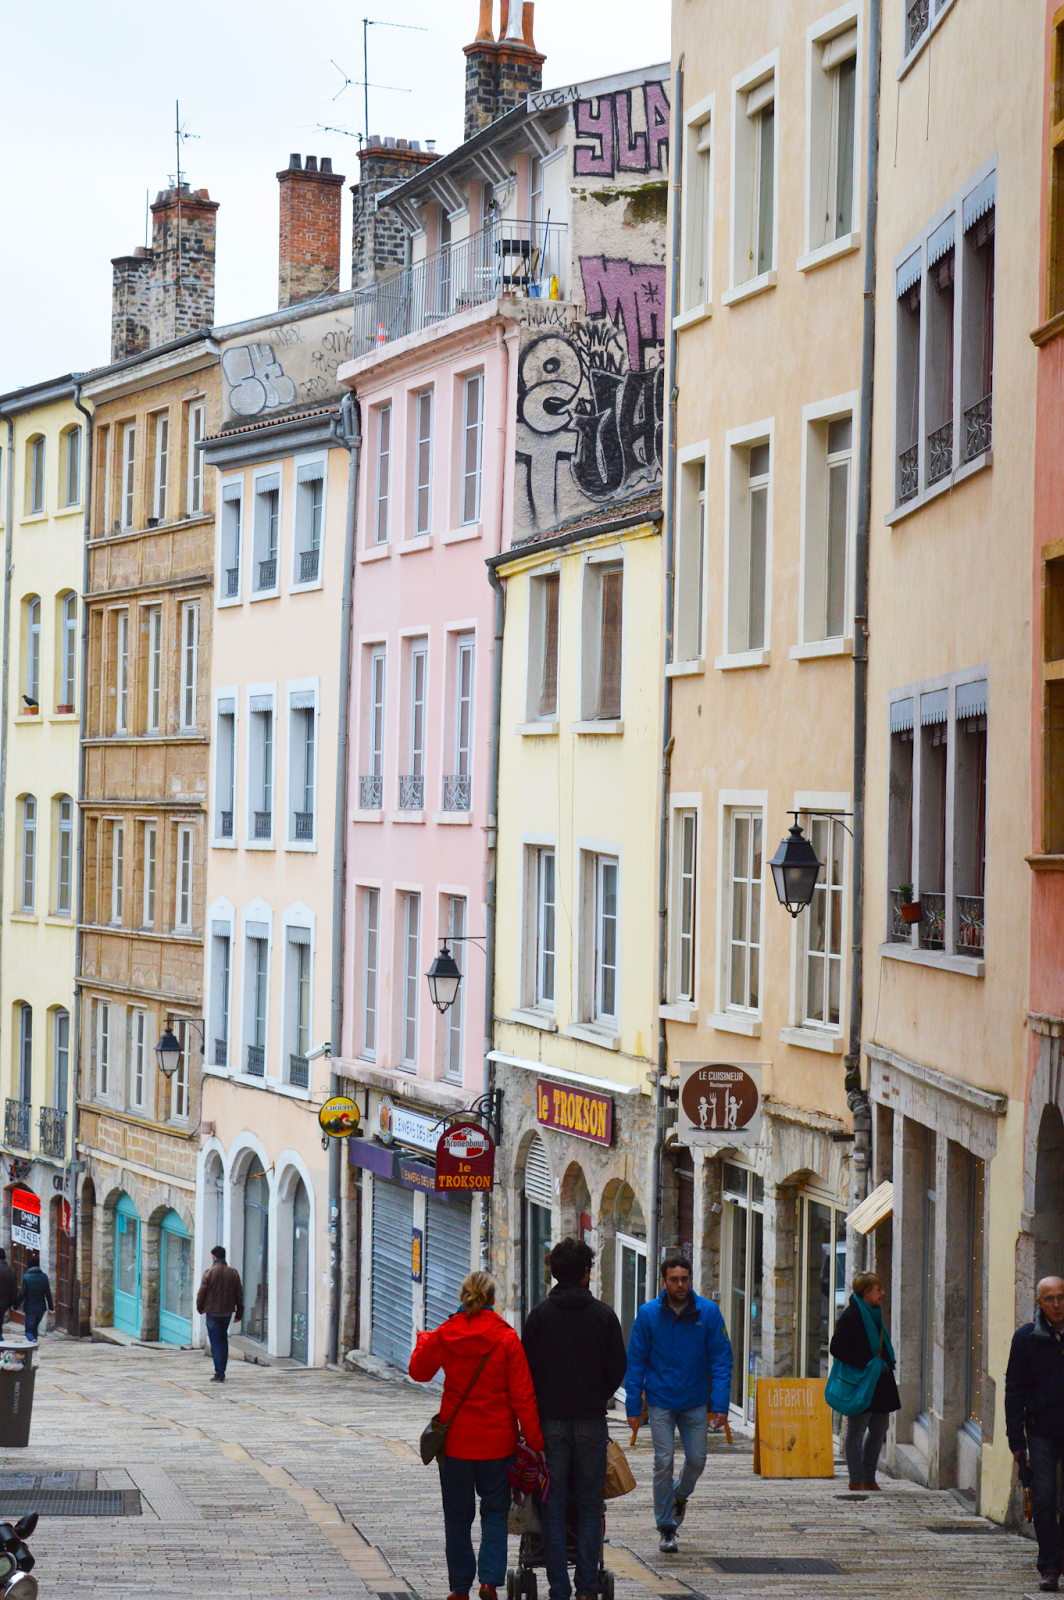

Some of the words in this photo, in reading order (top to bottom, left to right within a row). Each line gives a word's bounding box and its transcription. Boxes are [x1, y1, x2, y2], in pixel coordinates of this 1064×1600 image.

[699, 1071, 707, 1080] LE
[708, 1071, 743, 1081] CUISINEUR
[537, 1084, 549, 1121] le
[553, 1088, 608, 1139] TROKSON
[443, 1135, 490, 1152] Kronenbourg
[458, 1162, 472, 1173] le
[438, 1175, 492, 1188] TROKSON
